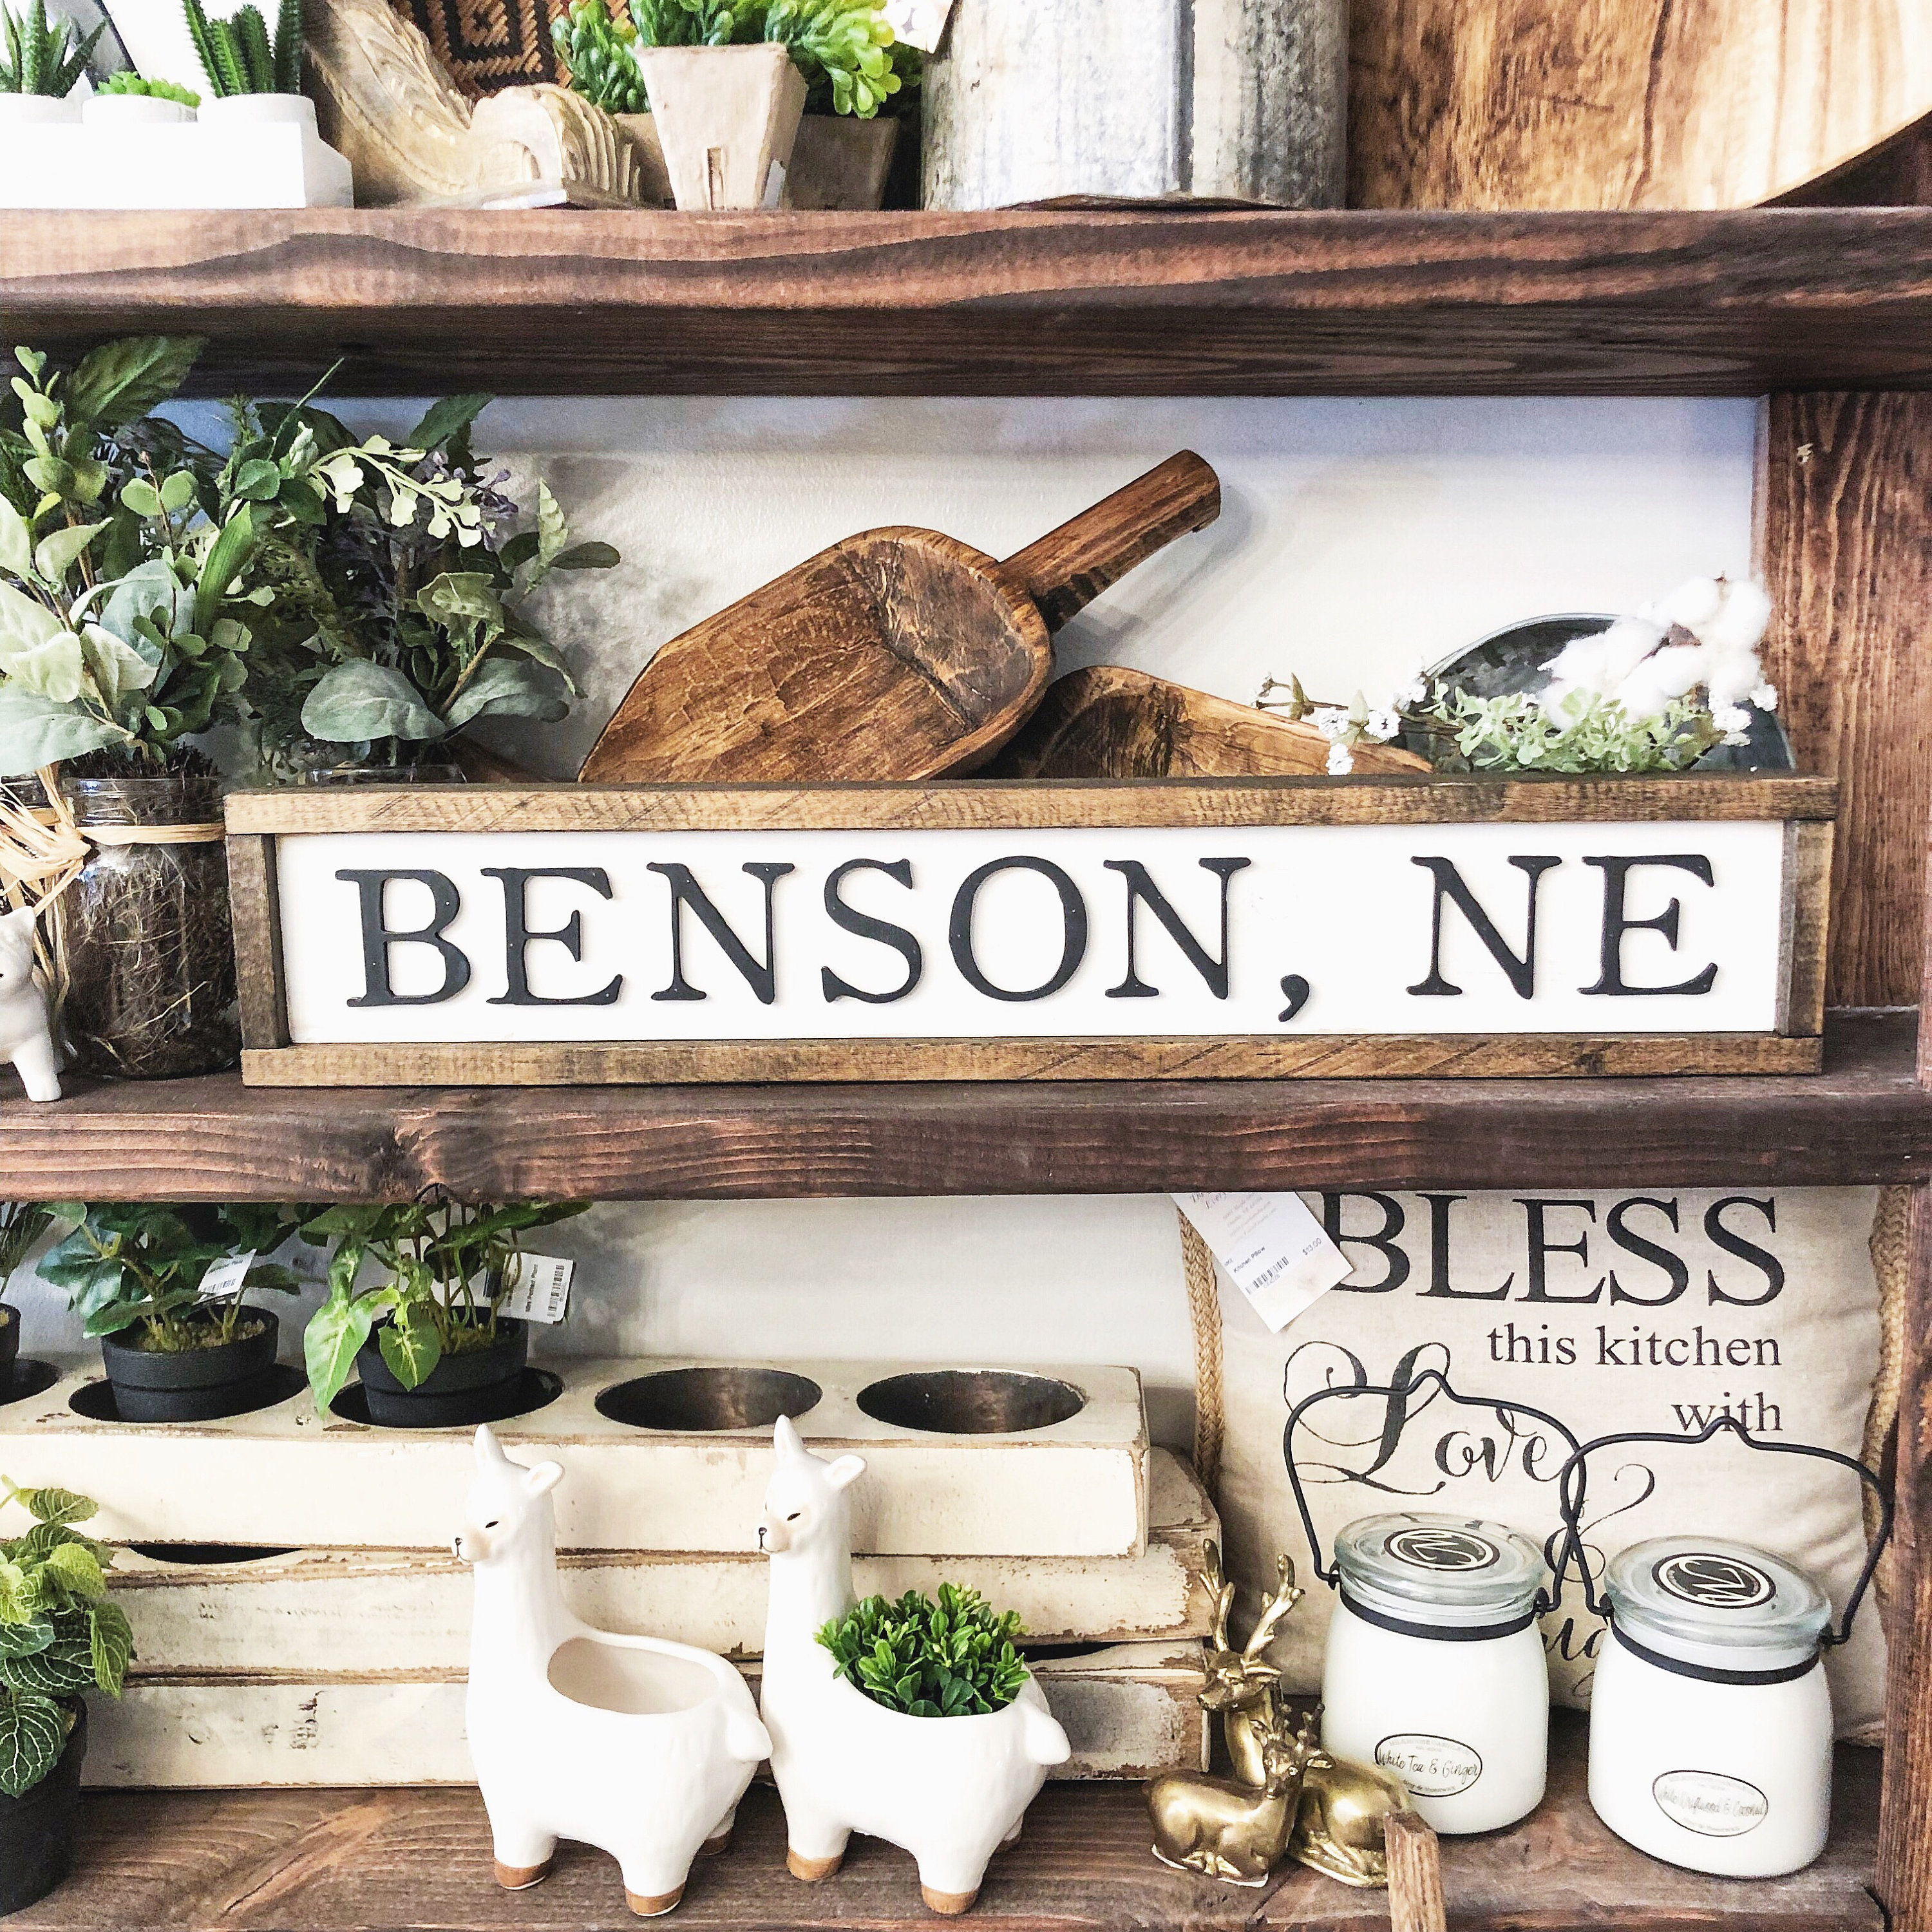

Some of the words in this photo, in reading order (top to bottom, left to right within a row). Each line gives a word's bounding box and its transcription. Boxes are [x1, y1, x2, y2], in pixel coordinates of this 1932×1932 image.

[334, 855, 1310, 1023] BENSON,
[1405, 855, 1719, 1000] NE
[1233, 1257, 1251, 1273] Kitchen
[1302, 1237, 1322, 1256] $13.00
[1320, 1190, 1786, 1307] BLESS
[1486, 1323, 1577, 1365] this
[1595, 1325, 1783, 1366] kitchen
[1283, 1340, 1566, 1495] Love
[1671, 1391, 1784, 1432] with
[1378, 1747, 1406, 1770] White
[1407, 1755, 1425, 1773] Tea
[1429, 1758, 1439, 1775] &
[1442, 1760, 1478, 1785] Ginger
